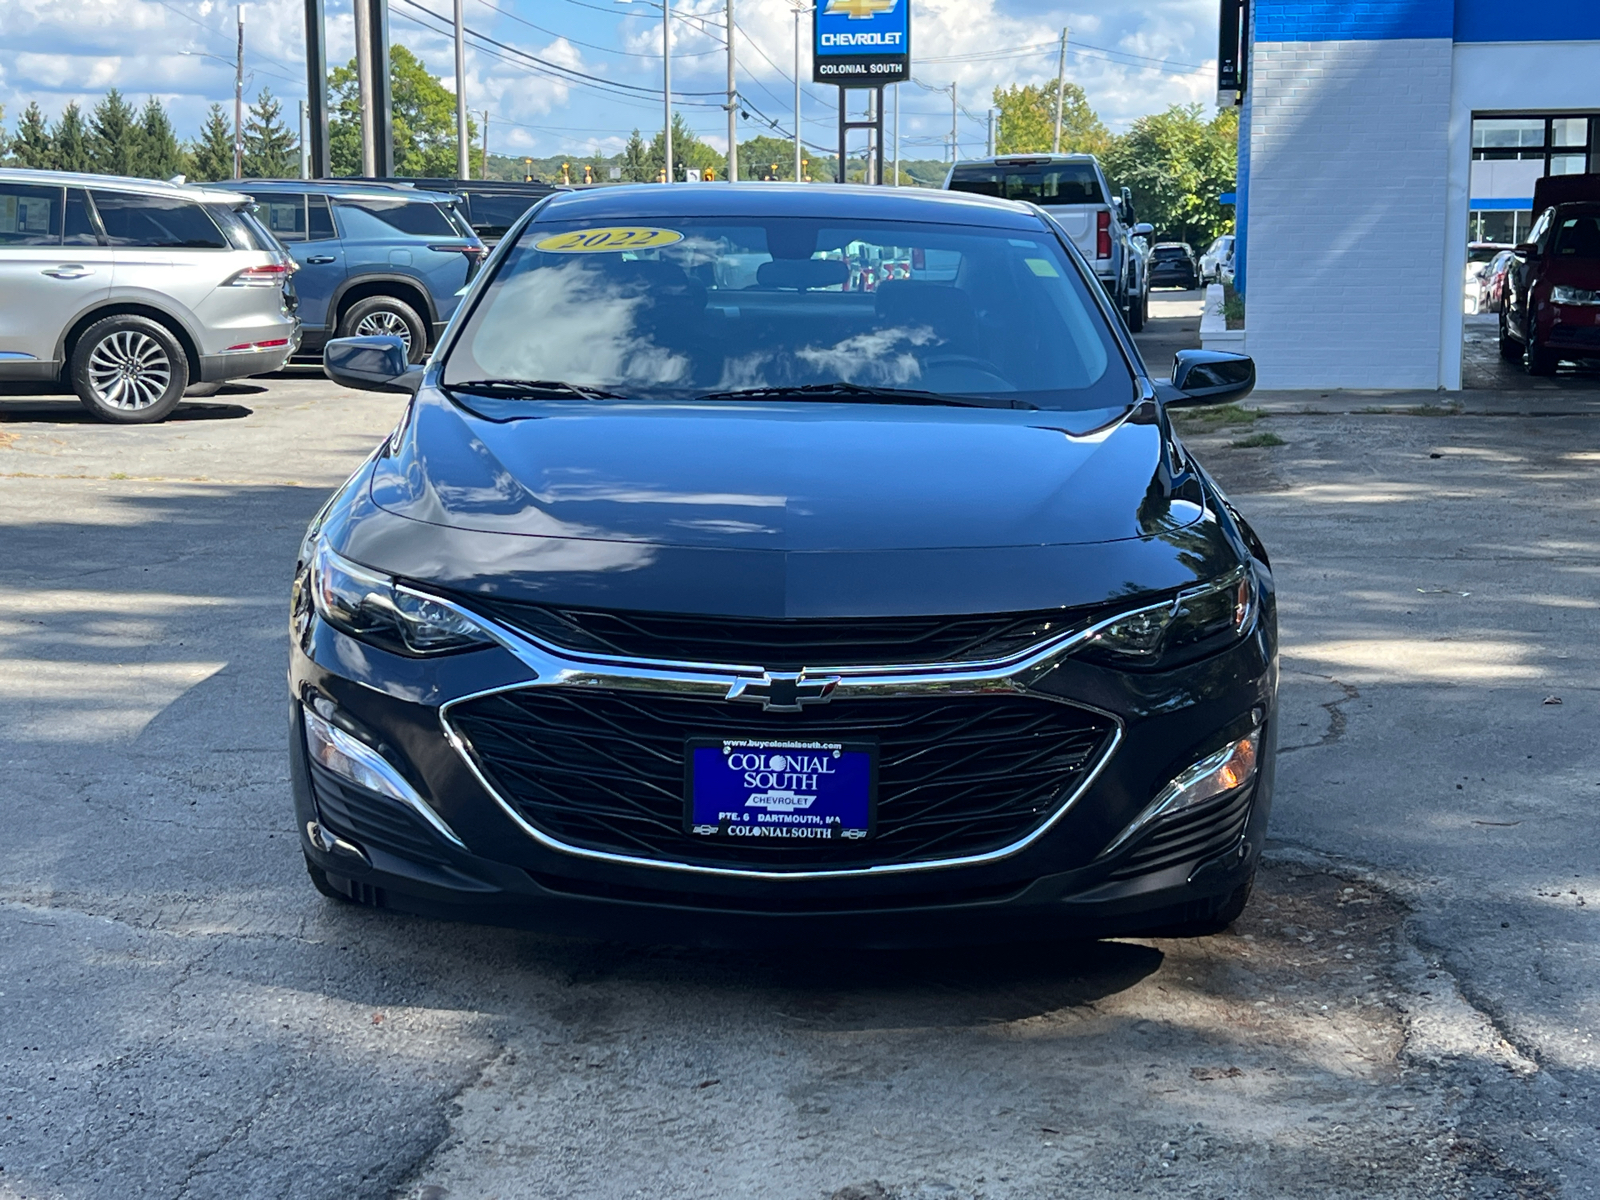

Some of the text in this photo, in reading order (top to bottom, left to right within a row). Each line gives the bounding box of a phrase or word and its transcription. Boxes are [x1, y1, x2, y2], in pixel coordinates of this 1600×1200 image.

[821, 32, 902, 46] CHEVROLET
[820, 63, 903, 74] COLONIAL SOUTH
[555, 231, 660, 249] 2022
[723, 739, 842, 750] www.buycolonialsouth.com
[727, 753, 836, 774] COLONIAL
[744, 772, 818, 790] SOUTH
[752, 796, 809, 806] CHEVROLET
[743, 813, 750, 821] 6
[757, 813, 823, 825] DARTMOUTH,
[727, 825, 832, 839] COLONIAL SOUTH
